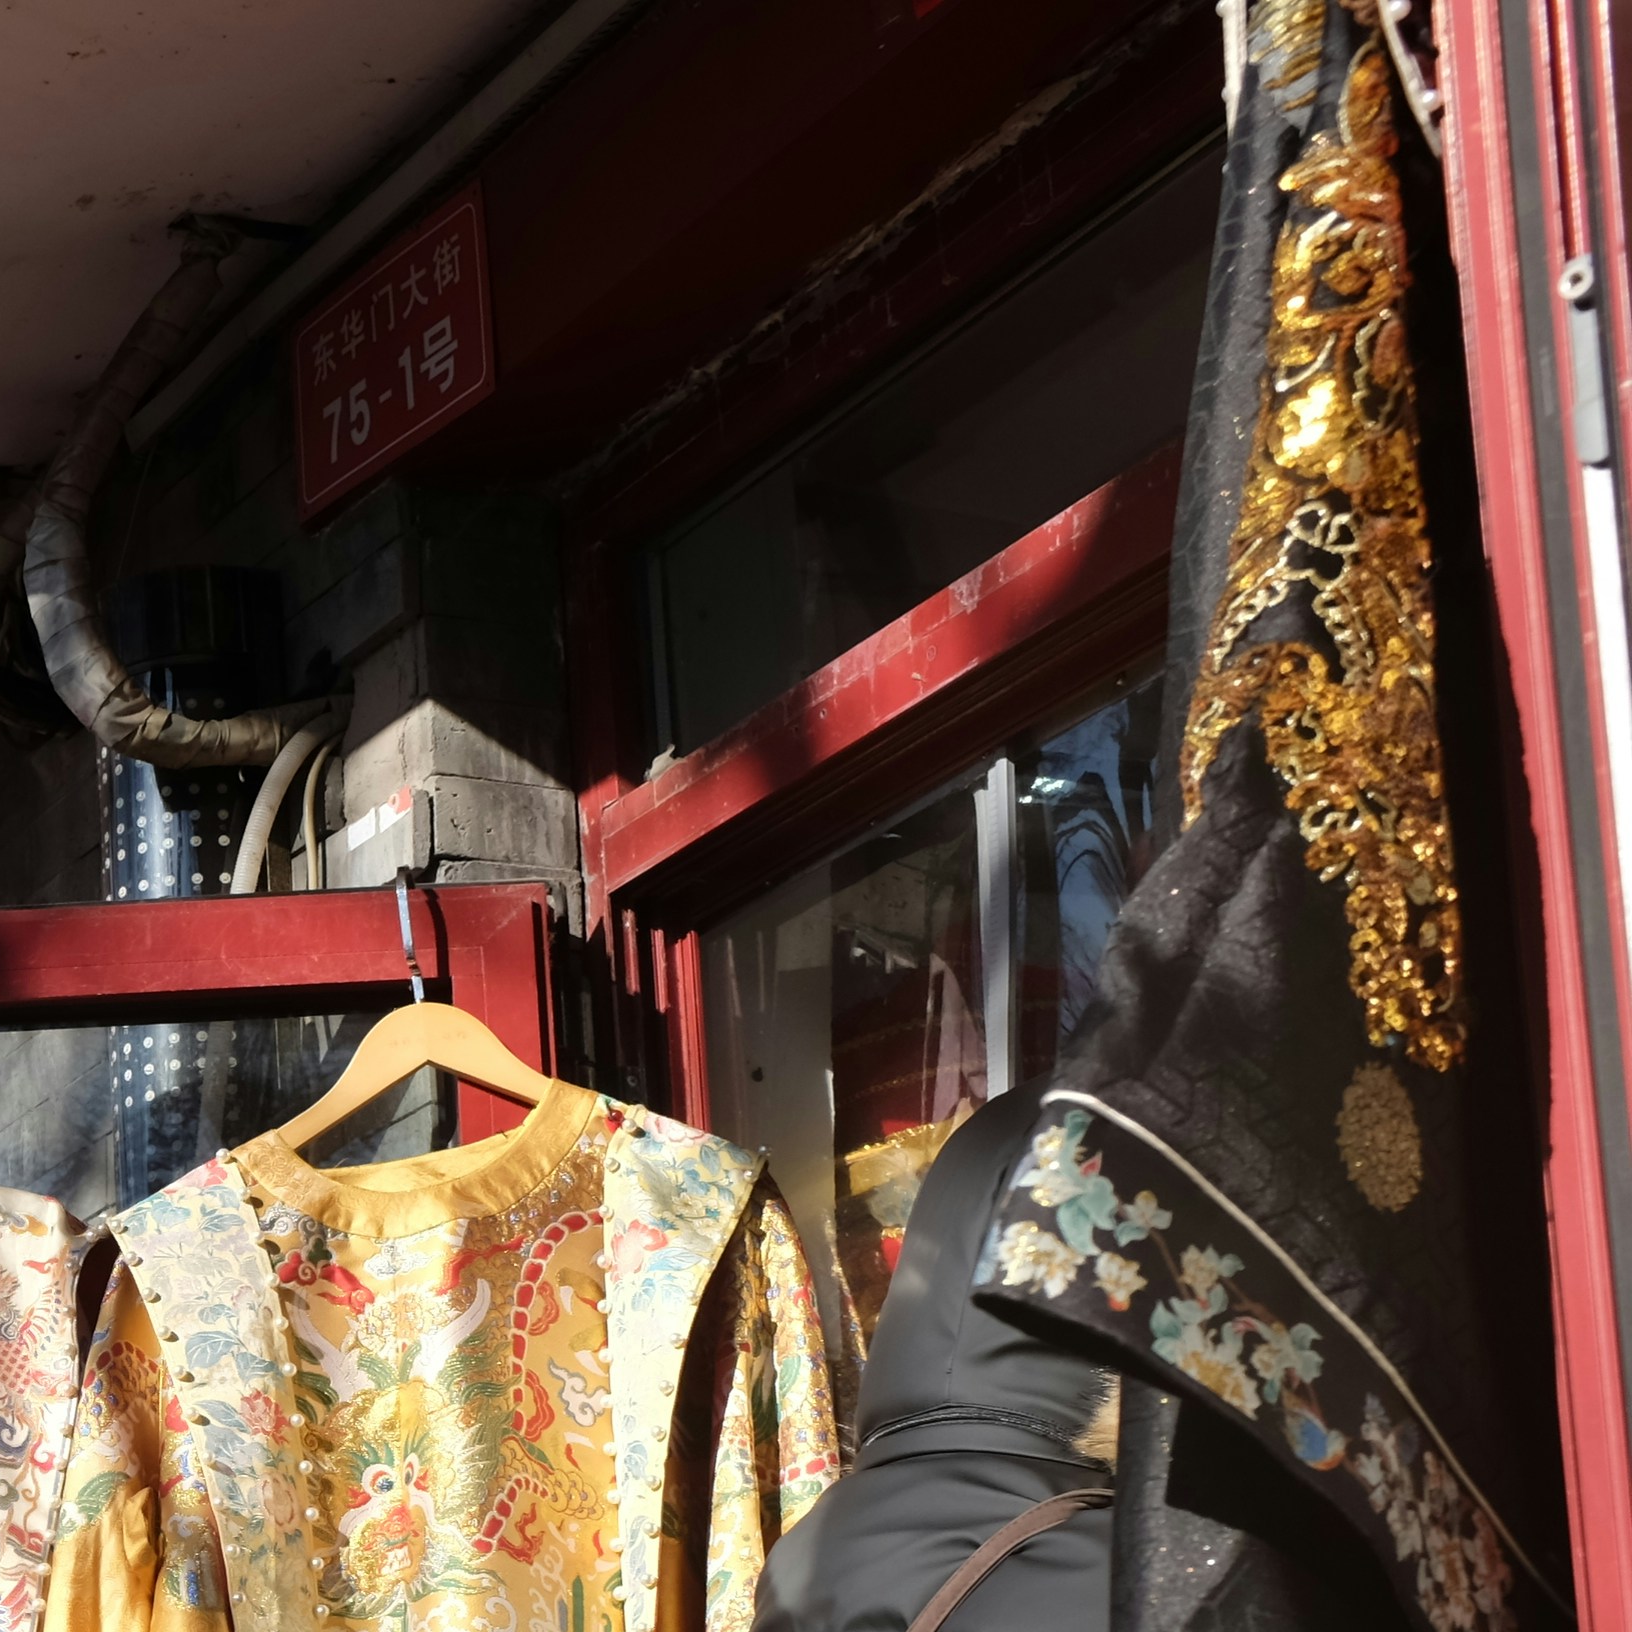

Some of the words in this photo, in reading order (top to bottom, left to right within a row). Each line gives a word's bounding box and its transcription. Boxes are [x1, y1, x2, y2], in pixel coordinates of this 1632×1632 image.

[312, 234, 462, 387] 东华门大街
[322, 315, 459, 464] 75-1号
